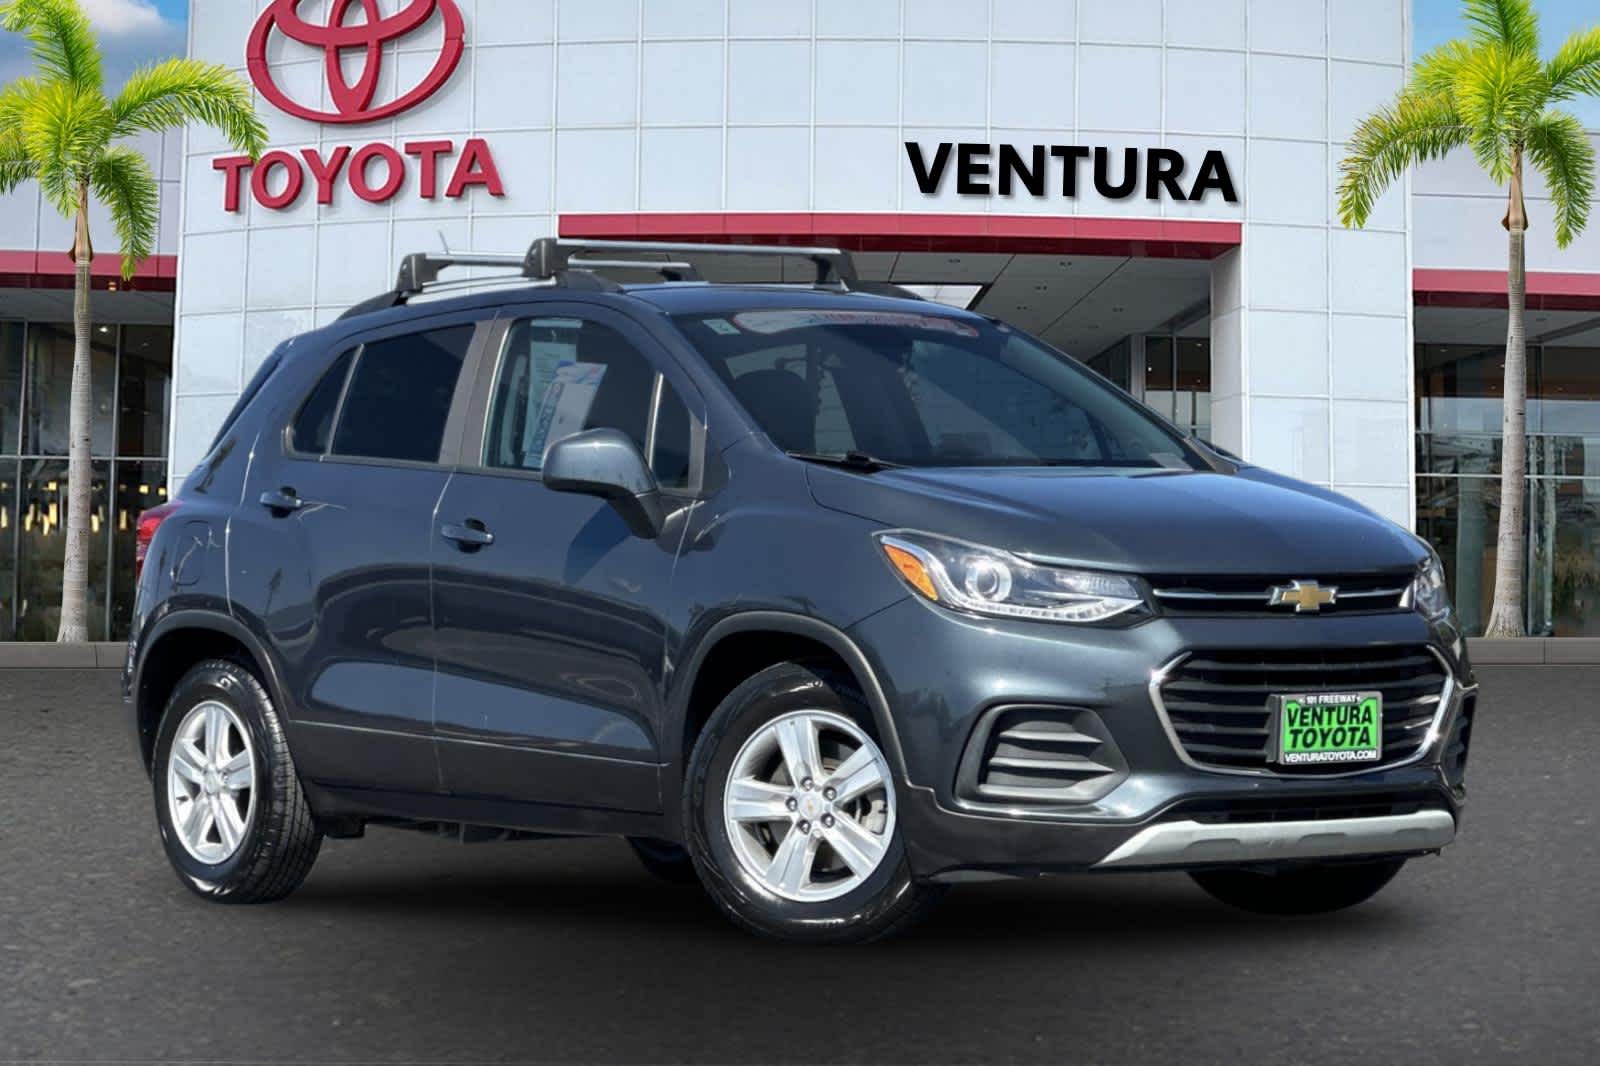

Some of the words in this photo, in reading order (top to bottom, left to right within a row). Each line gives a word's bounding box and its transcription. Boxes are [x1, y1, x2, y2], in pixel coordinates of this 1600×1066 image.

[212, 138, 505, 212] TOYOTA
[904, 141, 1239, 203] VENTURA
[1319, 694, 1357, 704] FREEWAY
[1287, 705, 1373, 727] VENTURA
[1289, 726, 1371, 748] TOYOTA
[1284, 750, 1377, 763] VENTURATOYOTA.COM
